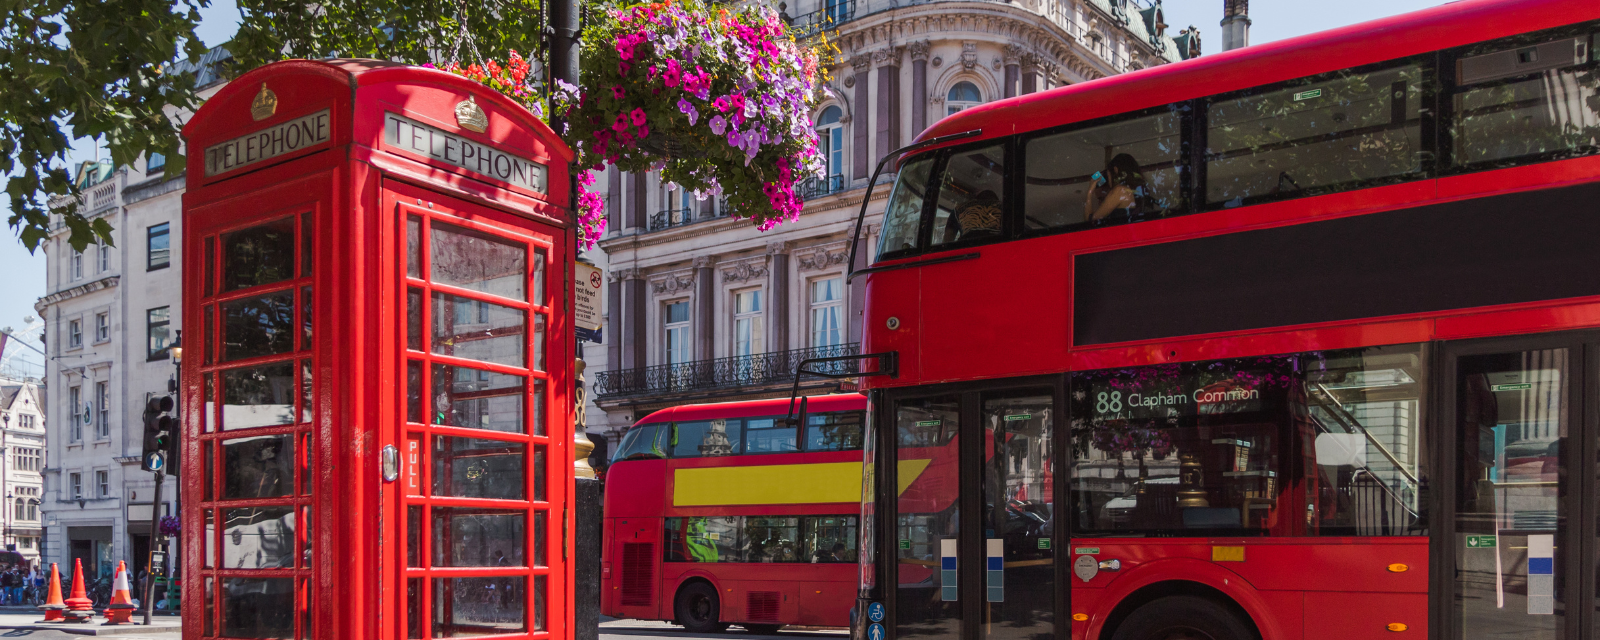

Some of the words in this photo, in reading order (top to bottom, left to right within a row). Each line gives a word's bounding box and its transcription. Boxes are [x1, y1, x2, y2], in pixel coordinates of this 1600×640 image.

[207, 113, 328, 172] TELEPHONE
[388, 116, 541, 190] TELEPHONE
[575, 286, 584, 294] not
[585, 288, 596, 297] feed
[577, 294, 590, 303] birds
[1096, 390, 1123, 413] 88
[1128, 392, 1187, 410] Clapham
[1193, 389, 1259, 403] Common
